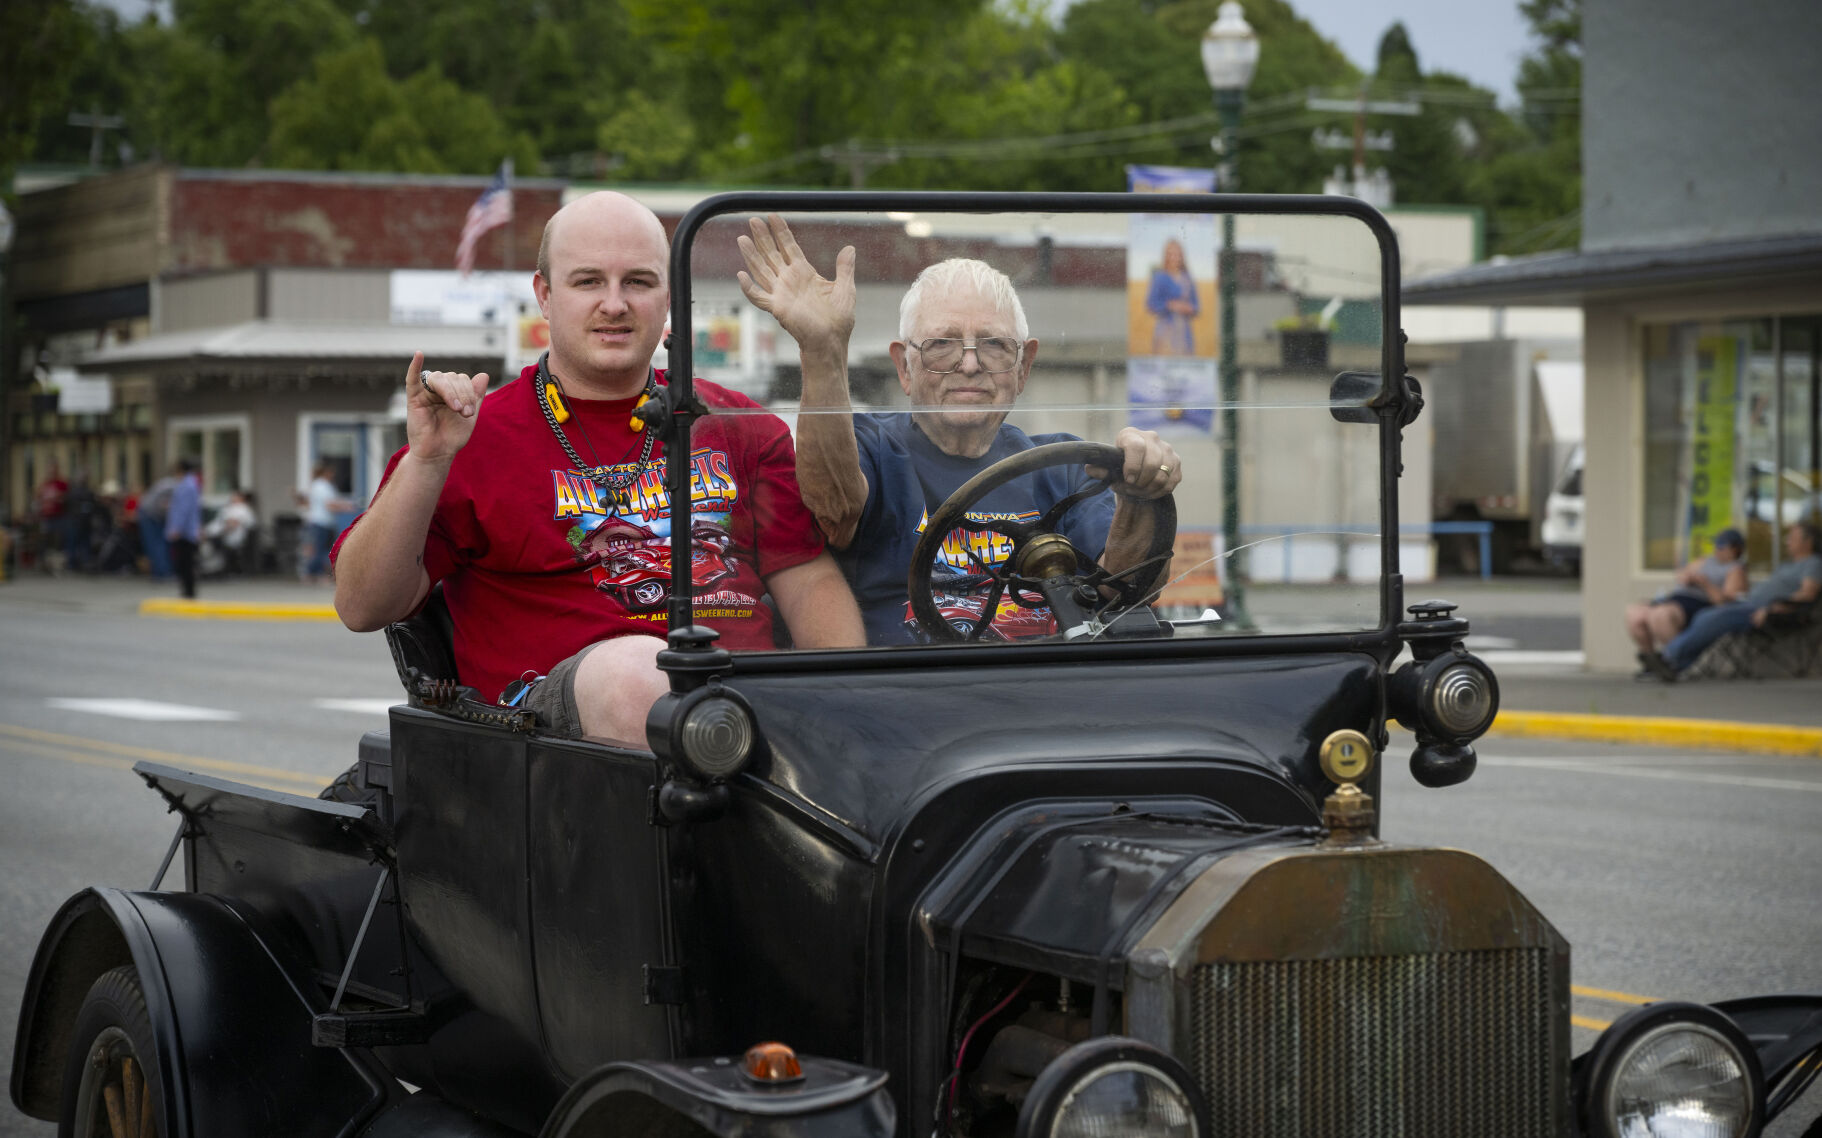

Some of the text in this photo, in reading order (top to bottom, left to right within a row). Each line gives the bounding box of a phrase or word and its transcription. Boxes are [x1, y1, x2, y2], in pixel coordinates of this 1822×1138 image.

[553, 452, 738, 517] ALL WHELS
[637, 496, 732, 522] Weend
[941, 527, 1015, 568] WHE
